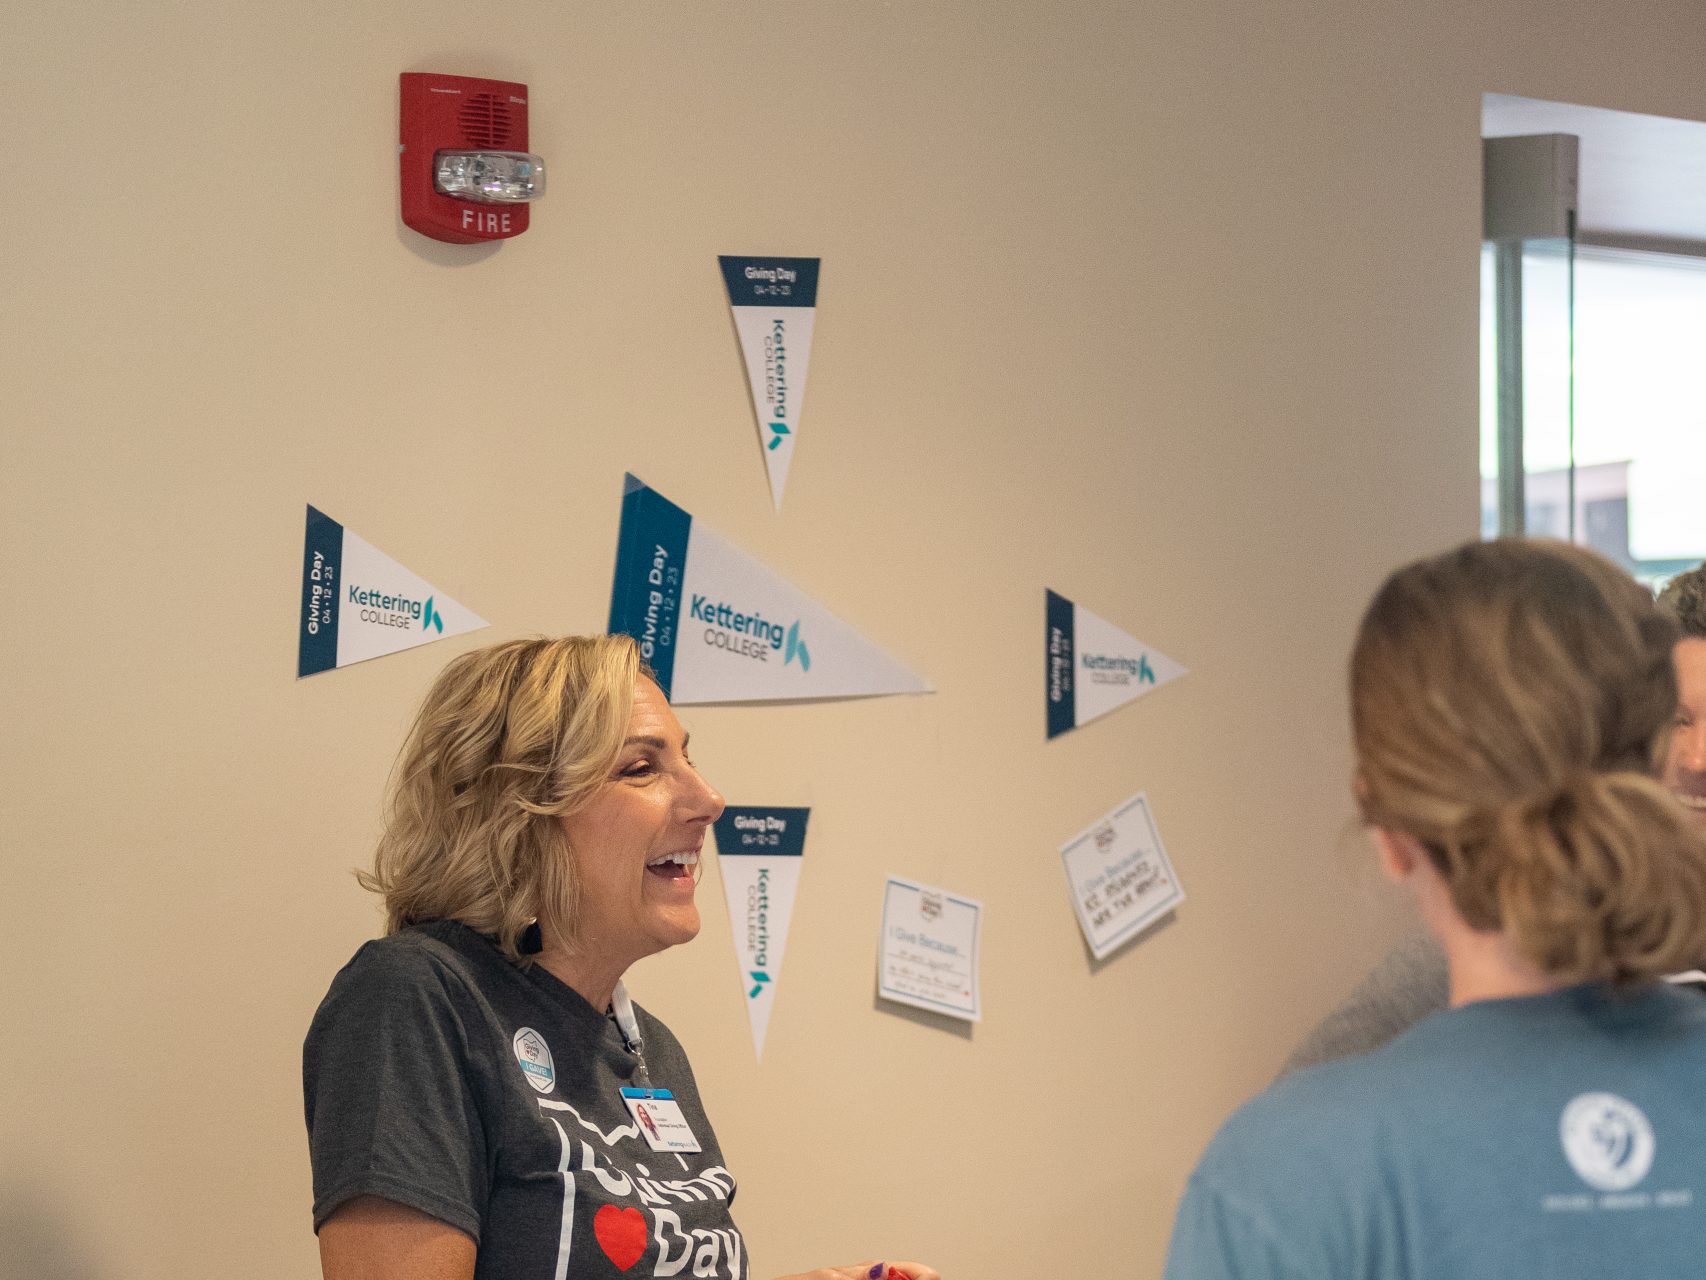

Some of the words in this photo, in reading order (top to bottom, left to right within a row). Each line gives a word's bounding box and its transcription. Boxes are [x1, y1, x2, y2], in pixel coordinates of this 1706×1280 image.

[463, 210, 512, 233] FIRE
[745, 267, 776, 282] Giving
[777, 268, 796, 282] Day
[764, 336, 774, 403] COLLEGE
[773, 320, 787, 418] Kettering
[311, 551, 324, 581] Day
[649, 544, 668, 586] Day
[308, 585, 322, 634] Giving
[349, 585, 421, 620] Kettering
[360, 609, 410, 629] COLLEGE
[690, 593, 784, 649] Kettering
[641, 591, 663, 658] Giving
[704, 628, 769, 662] COLLEGE
[734, 815, 765, 832] Giving
[766, 816, 786, 832] Day
[755, 868, 769, 967] Kettering
